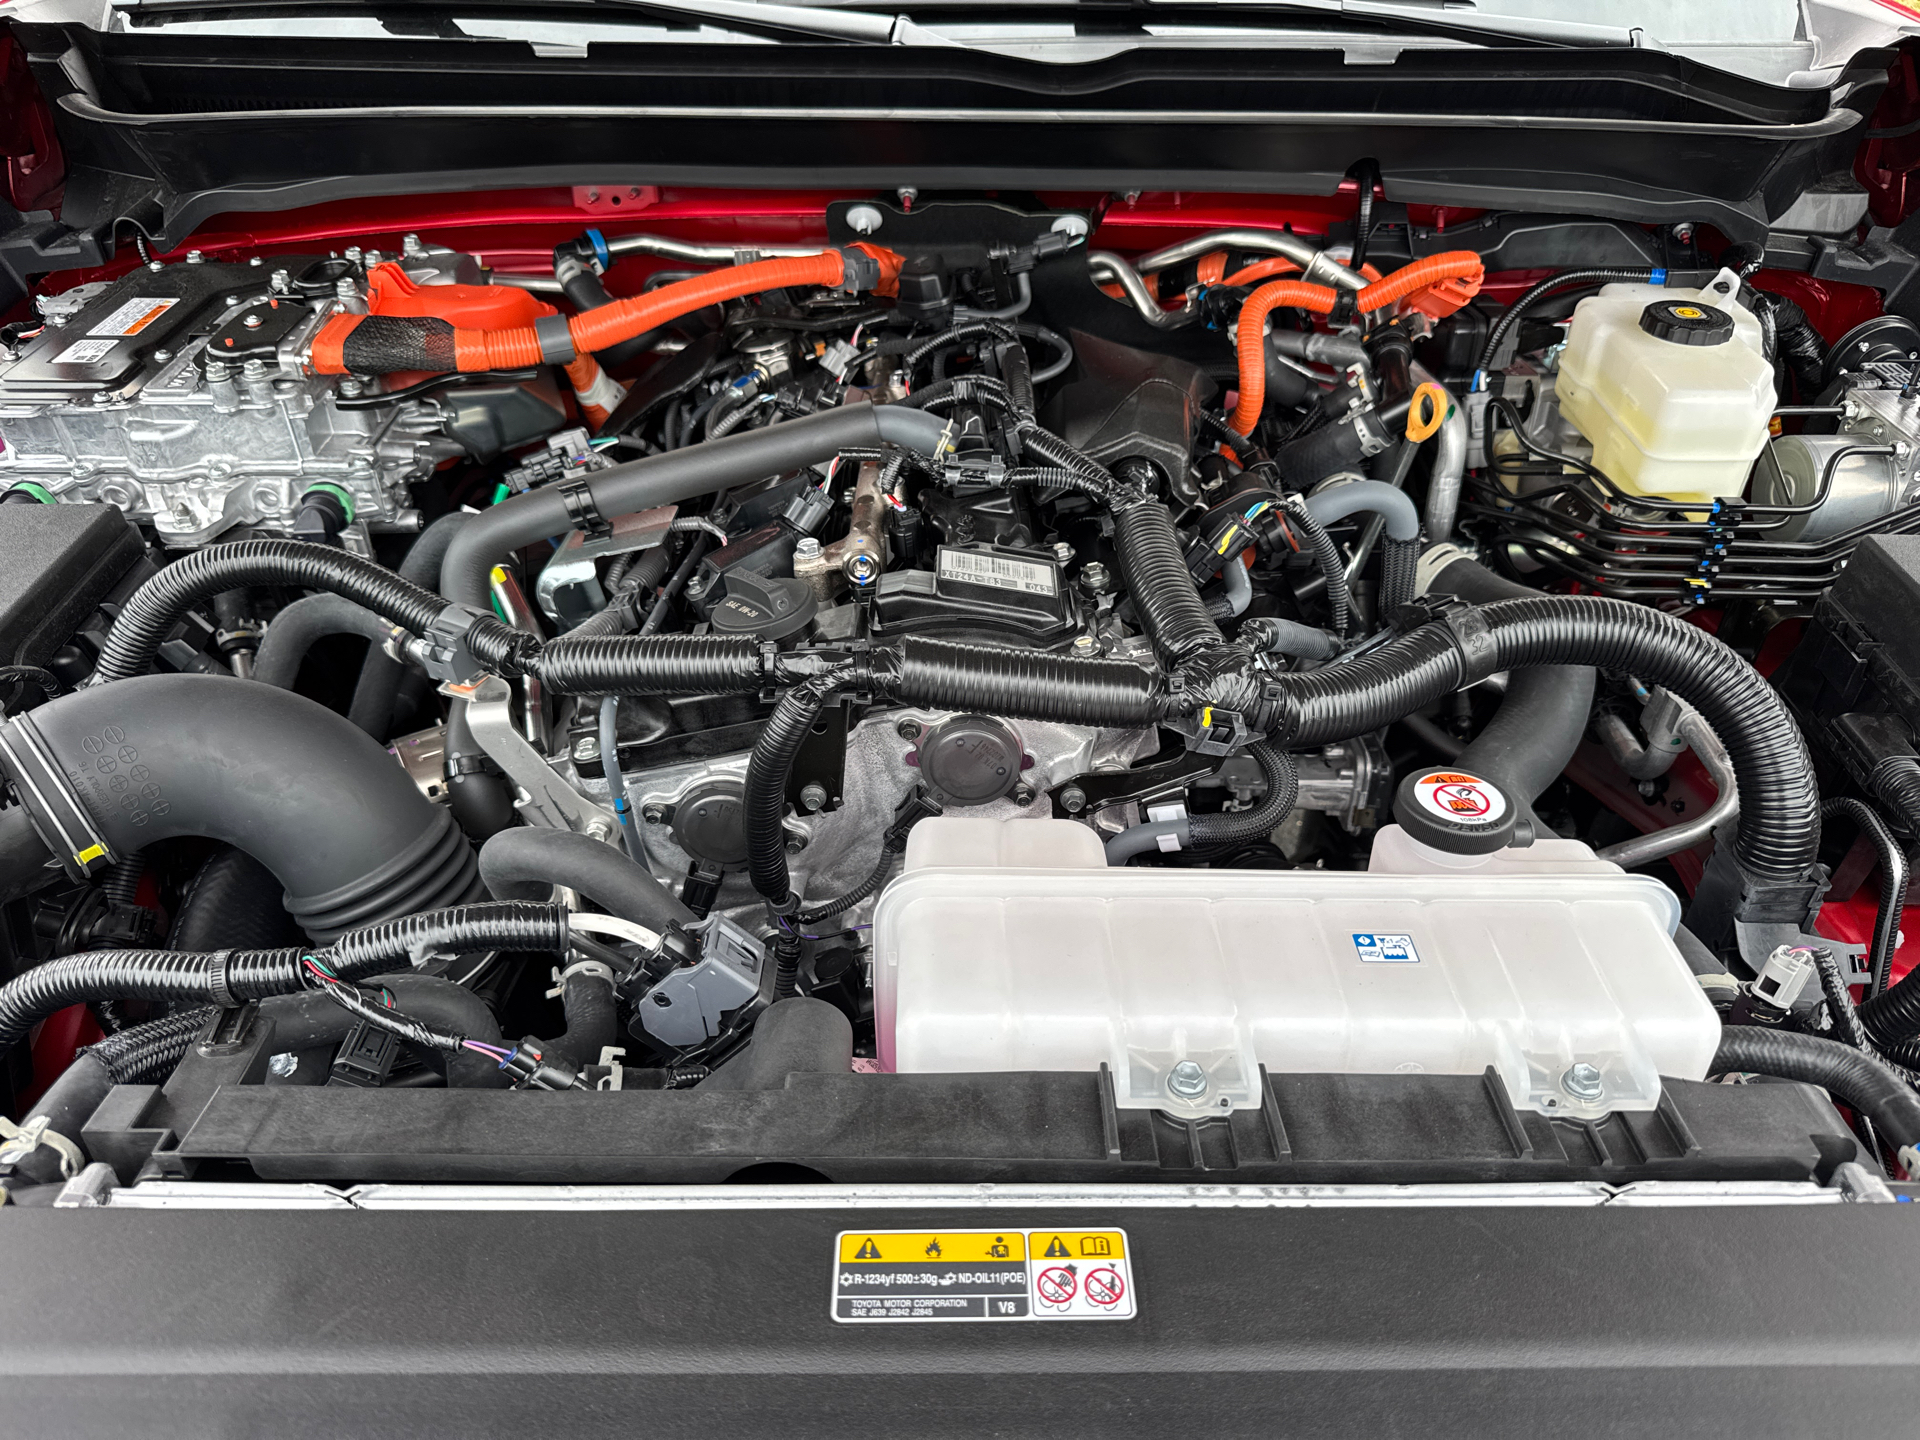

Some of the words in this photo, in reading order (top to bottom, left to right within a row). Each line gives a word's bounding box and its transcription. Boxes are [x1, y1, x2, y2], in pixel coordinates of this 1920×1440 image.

[944, 571, 1001, 586] XT24A-T83
[1030, 584, 1048, 593] 043
[725, 600, 741, 609] SAE
[738, 605, 759, 618] 0W-20
[1447, 822, 1500, 833] DENSO
[854, 1273, 895, 1287] R-1234yf
[896, 1273, 938, 1287] 500±30g
[958, 1272, 1026, 1286] ND-OIL11(POE)
[851, 1299, 882, 1308] TOYOTA
[883, 1299, 912, 1308] MOTOR
[913, 1298, 968, 1308] CORPORATION
[850, 1308, 867, 1316] SAE
[868, 1308, 887, 1316] J639
[888, 1308, 910, 1316] J2842
[911, 1308, 934, 1316] J2845
